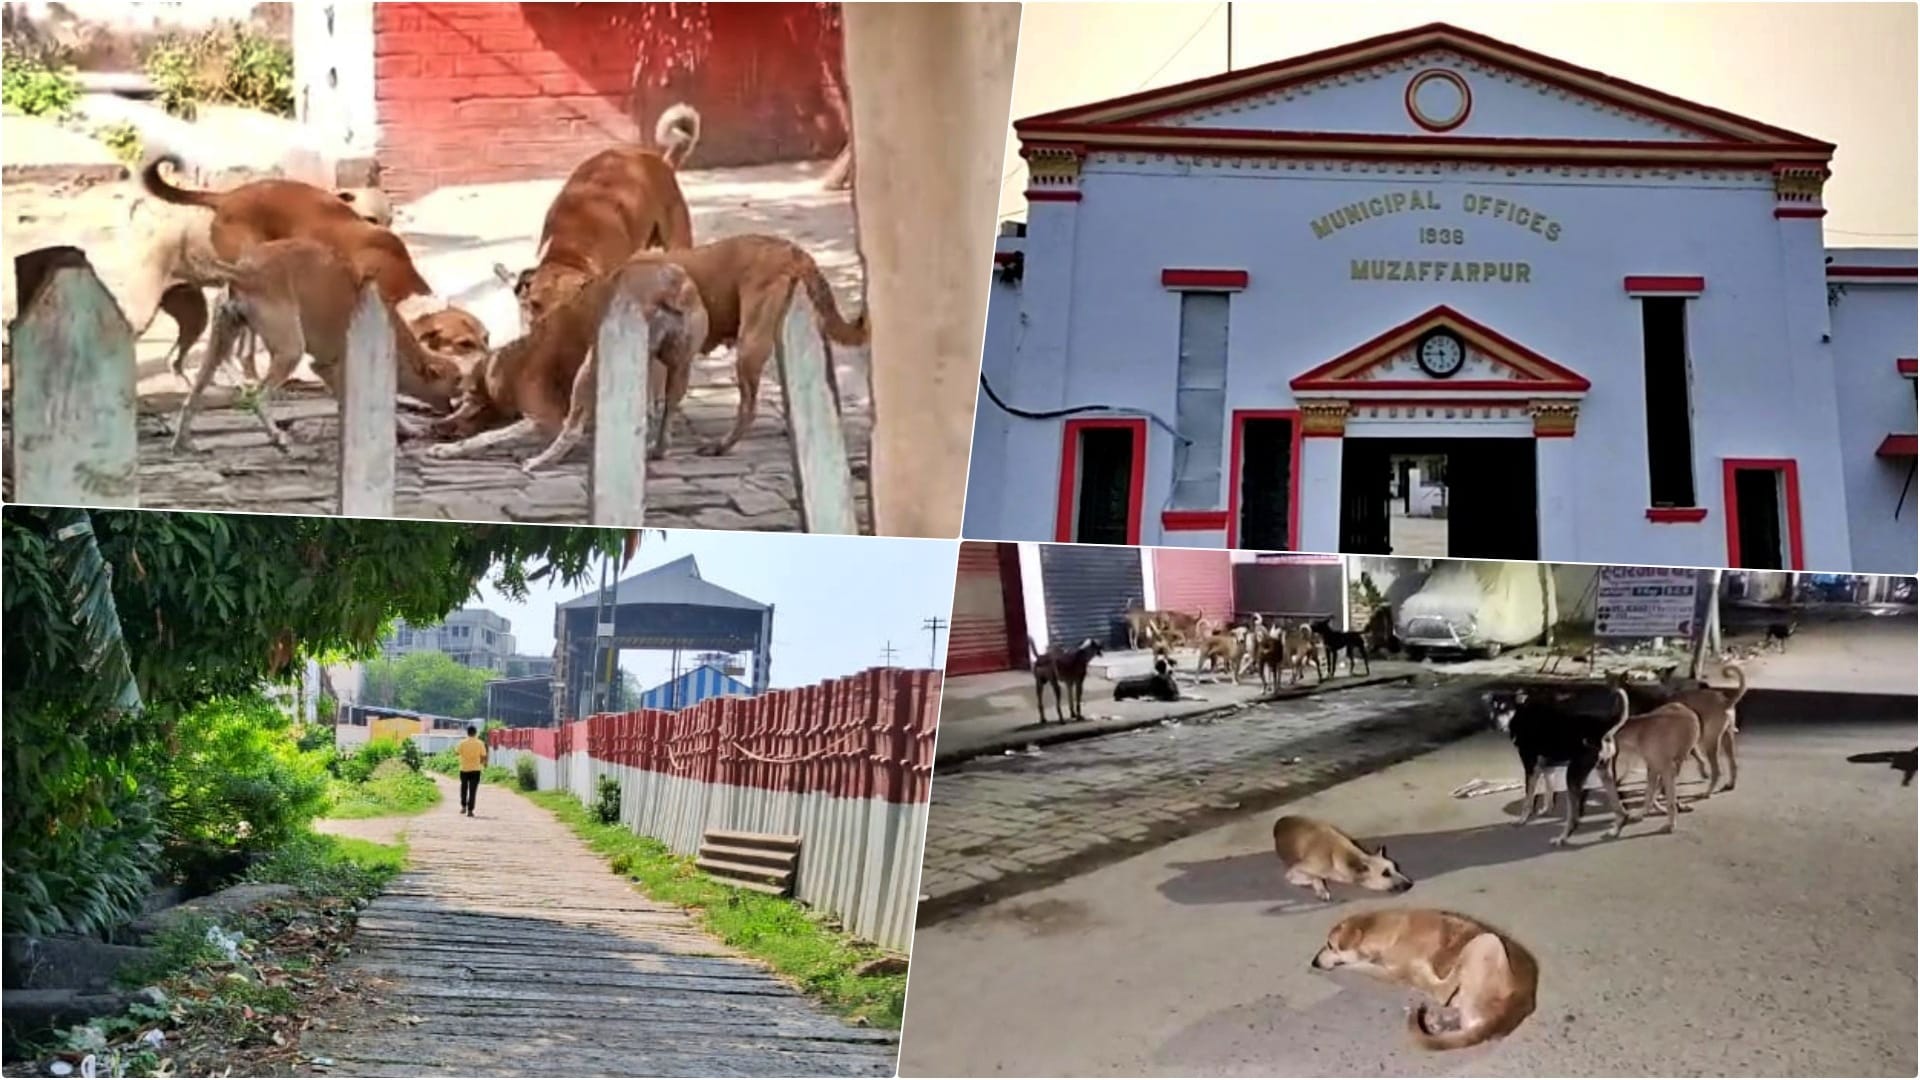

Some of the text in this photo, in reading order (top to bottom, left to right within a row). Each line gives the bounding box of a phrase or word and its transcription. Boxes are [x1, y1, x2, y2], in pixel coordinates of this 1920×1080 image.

[1310, 190, 1562, 242] MUNICIPAL OFFICES
[1350, 260, 1532, 283] MUZAFFARPUR
